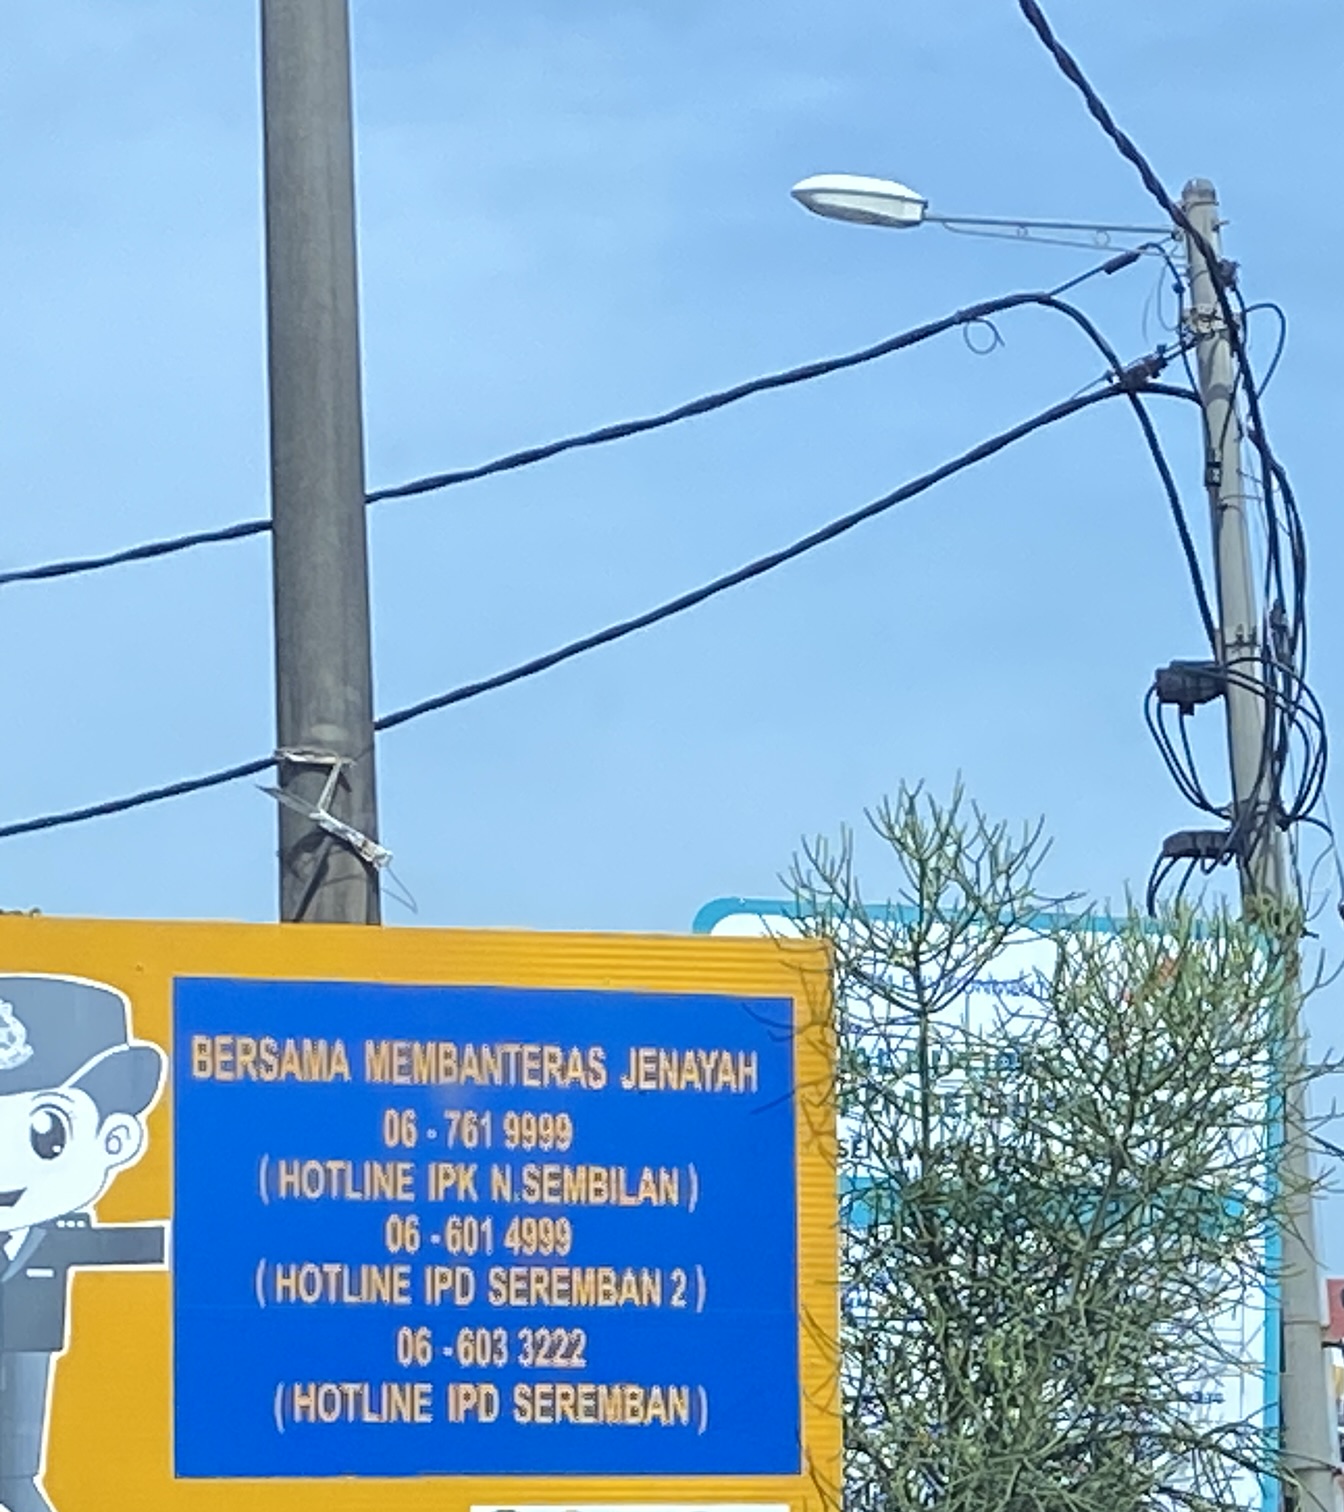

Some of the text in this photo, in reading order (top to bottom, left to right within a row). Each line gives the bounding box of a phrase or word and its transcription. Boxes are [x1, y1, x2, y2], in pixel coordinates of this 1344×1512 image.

[192, 1034, 758, 1094] BERSAMA MEMBANTERAS JENAYAH
[384, 1108, 417, 1148] 06
[444, 1109, 492, 1149] 761
[503, 1111, 573, 1151] 9999
[428, 1161, 478, 1203] IPK
[385, 1214, 420, 1253] 06
[504, 1216, 573, 1256] 4999
[424, 1263, 475, 1306] IPD
[488, 1266, 662, 1307] SEREMBAN
[397, 1326, 432, 1367] 06
[517, 1327, 587, 1369] 3222
[448, 1382, 500, 1424] IPD
